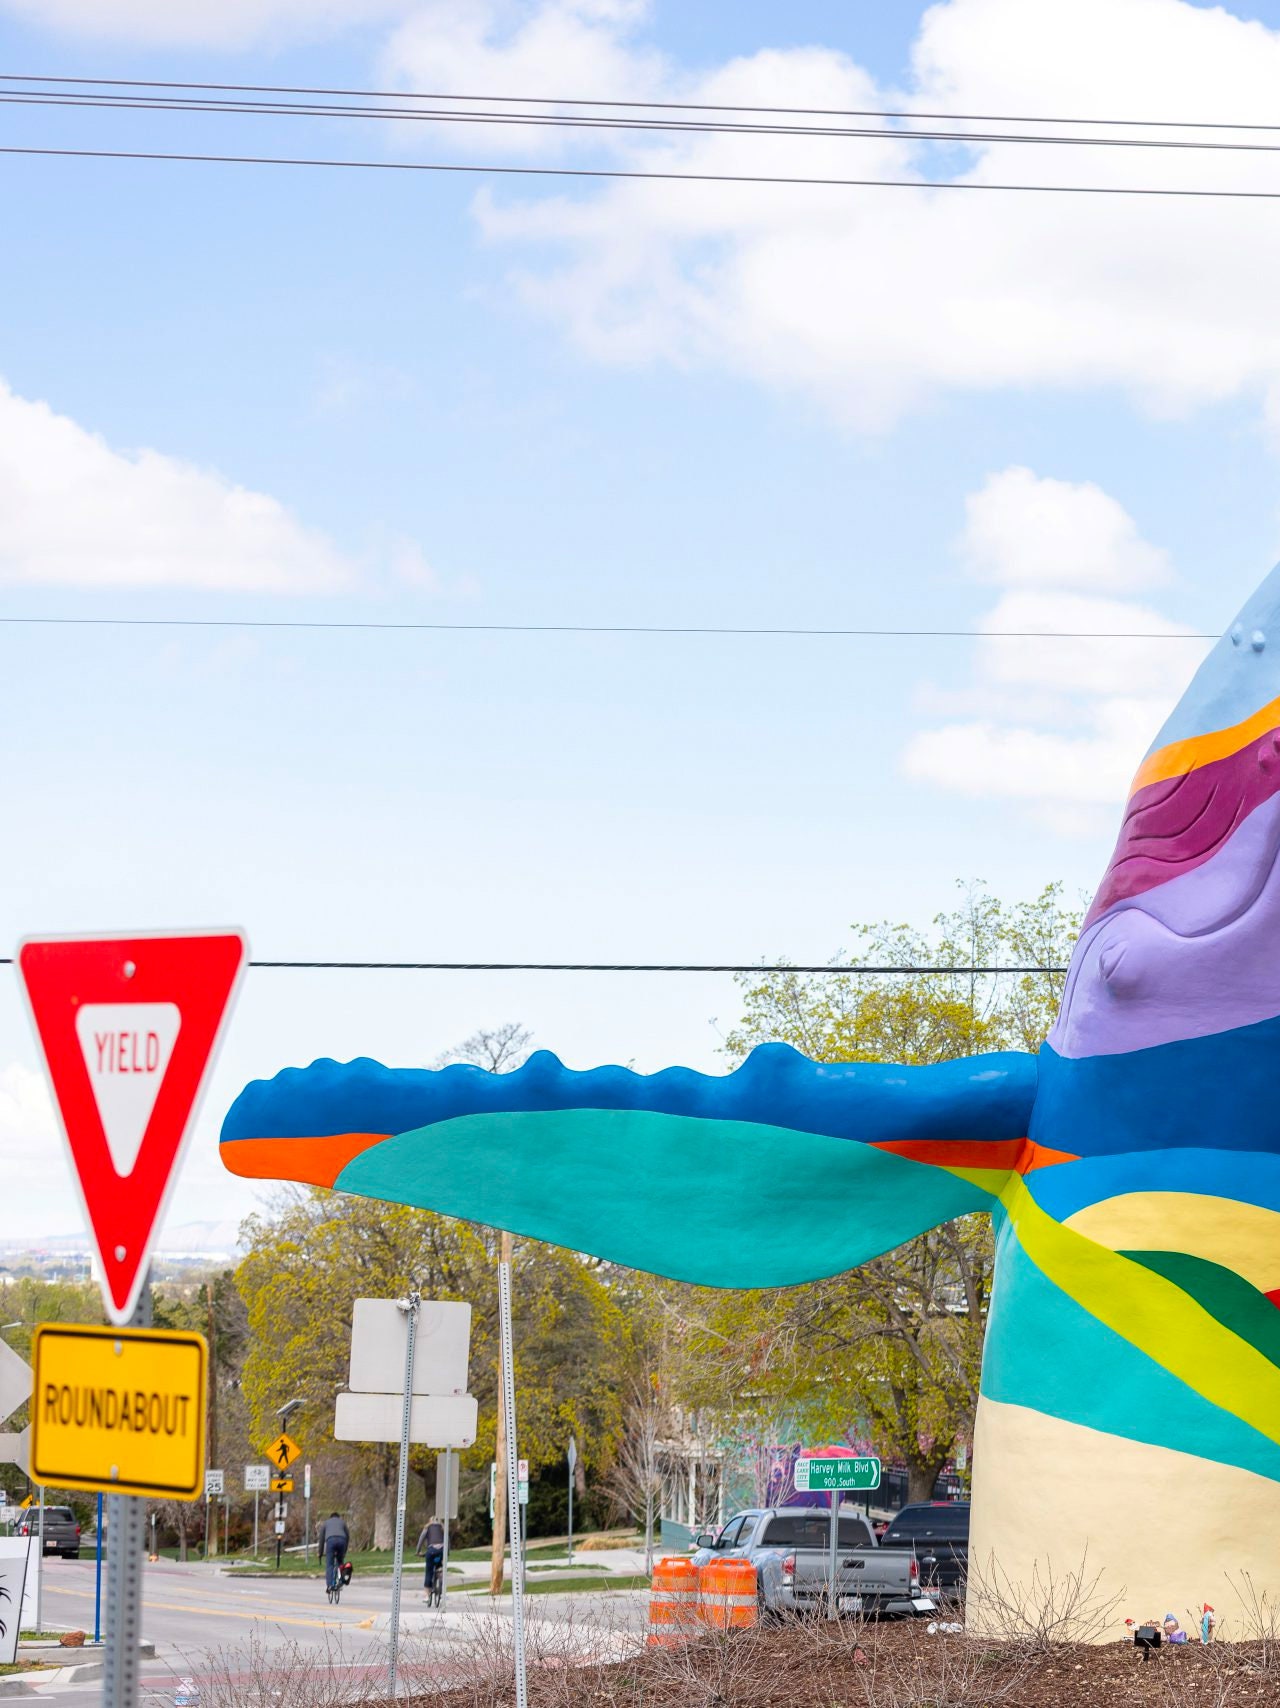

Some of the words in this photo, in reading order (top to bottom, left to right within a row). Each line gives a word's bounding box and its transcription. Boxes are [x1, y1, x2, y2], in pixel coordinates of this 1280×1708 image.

[94, 1031, 159, 1073] YIELD
[45, 1383, 190, 1436] ROUNDABOUT
[810, 1461, 834, 1477] Harvey
[837, 1461, 851, 1474] Milk
[854, 1461, 869, 1473] Blvd
[207, 1482, 221, 1492] 25
[823, 1477, 837, 1487] 900
[839, 1476, 856, 1487] South
